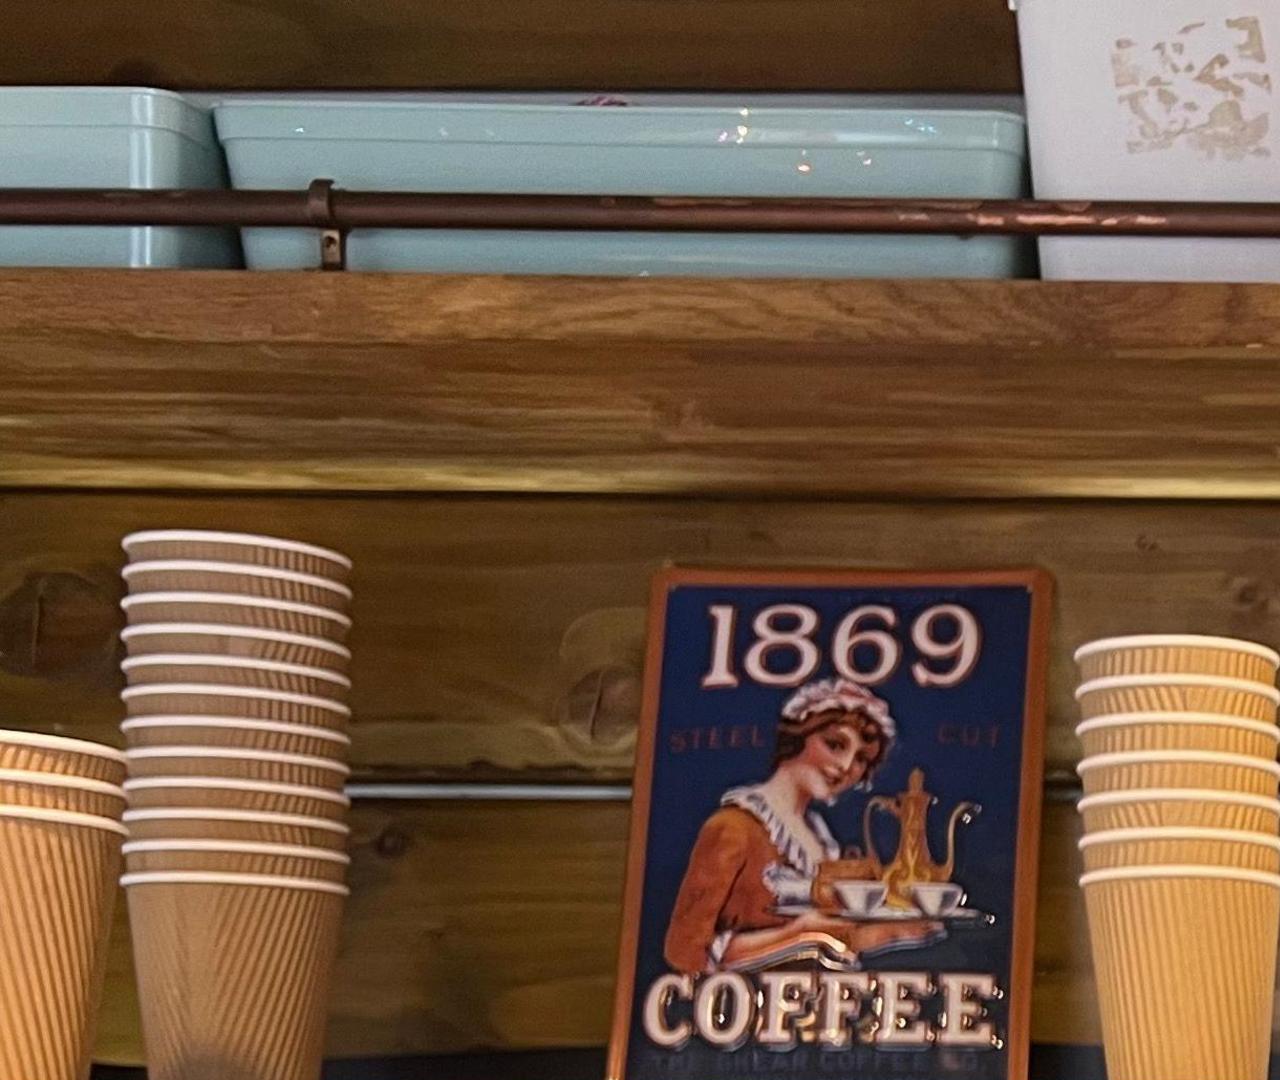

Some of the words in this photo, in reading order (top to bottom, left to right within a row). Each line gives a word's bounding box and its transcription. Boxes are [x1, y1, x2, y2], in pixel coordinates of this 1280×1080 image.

[701, 603, 981, 689] 1869
[670, 725, 765, 751] STEEL
[937, 724, 998, 747] CUT
[643, 972, 995, 1046] COFFEE
